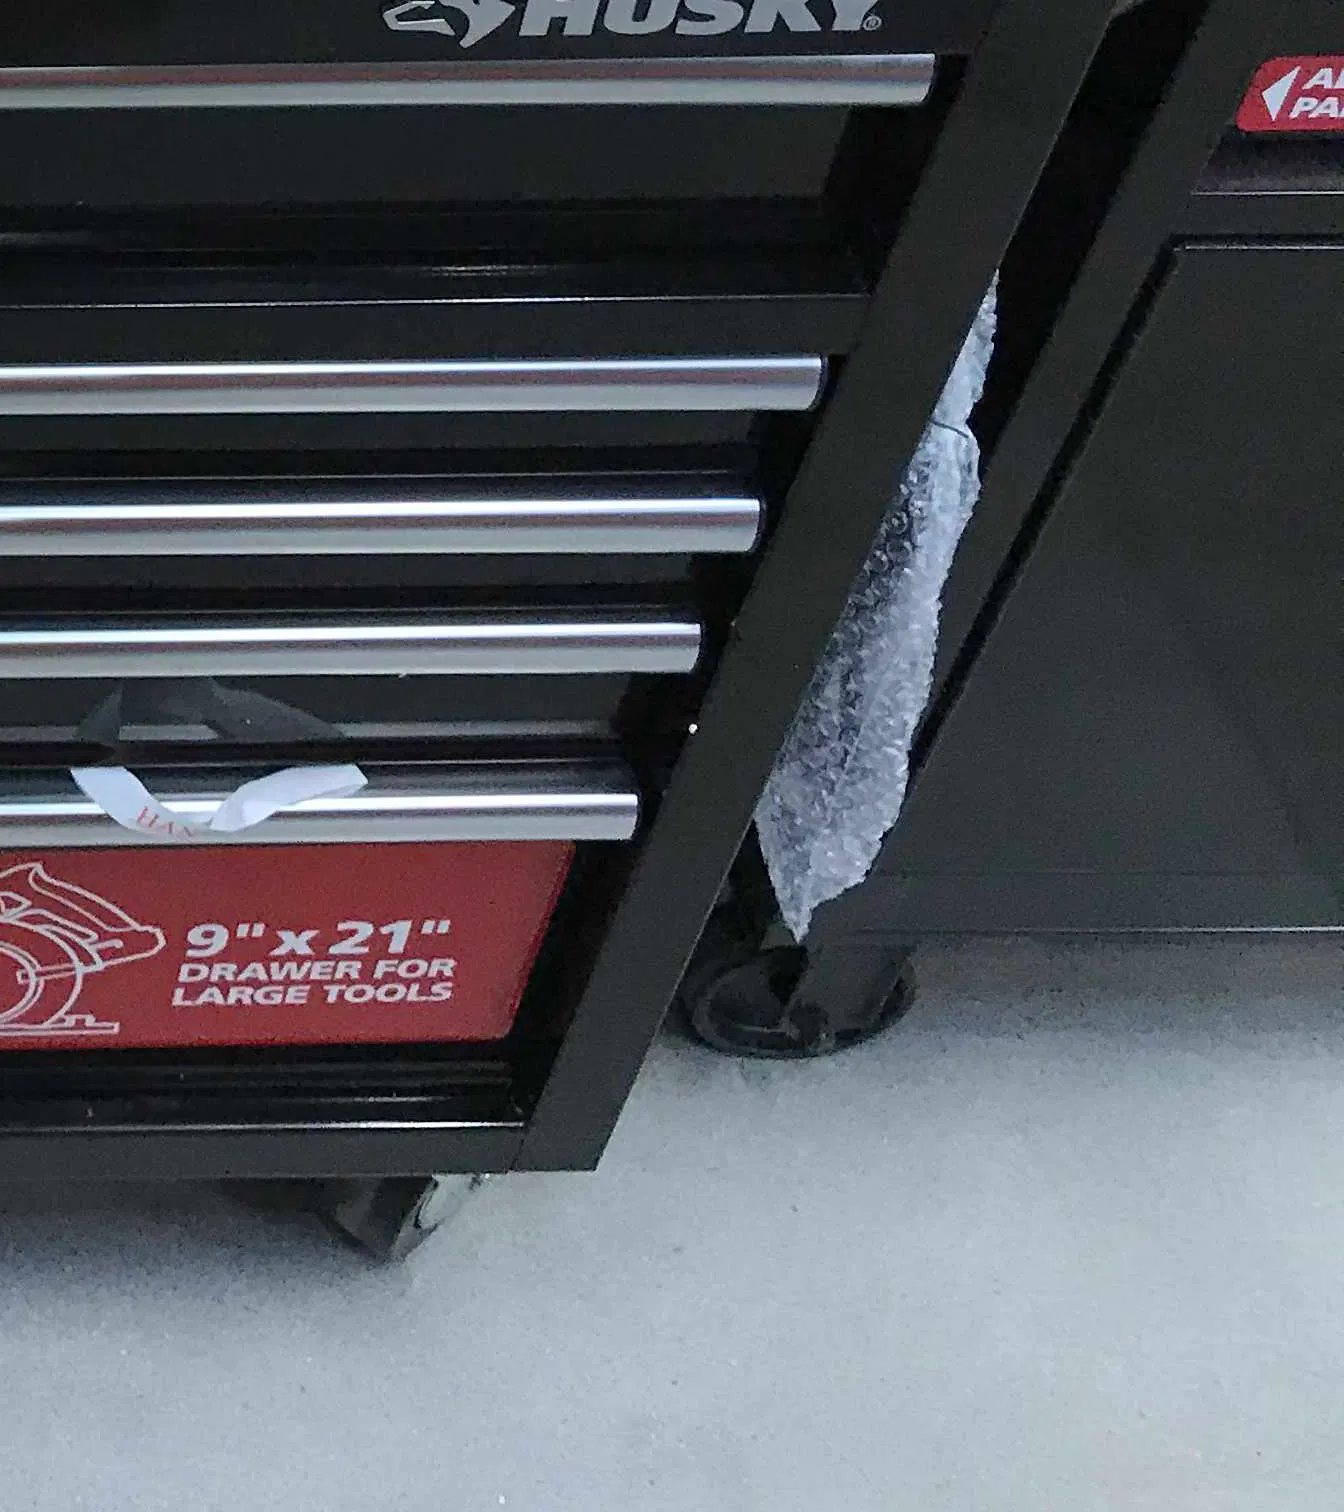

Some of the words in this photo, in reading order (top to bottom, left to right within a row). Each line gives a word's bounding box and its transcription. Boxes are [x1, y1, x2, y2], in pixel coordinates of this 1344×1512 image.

[178, 960, 361, 983] DRAWER
[373, 958, 458, 979] FOR
[172, 985, 311, 1006] LARGE
[324, 982, 453, 1004] TOOLS
